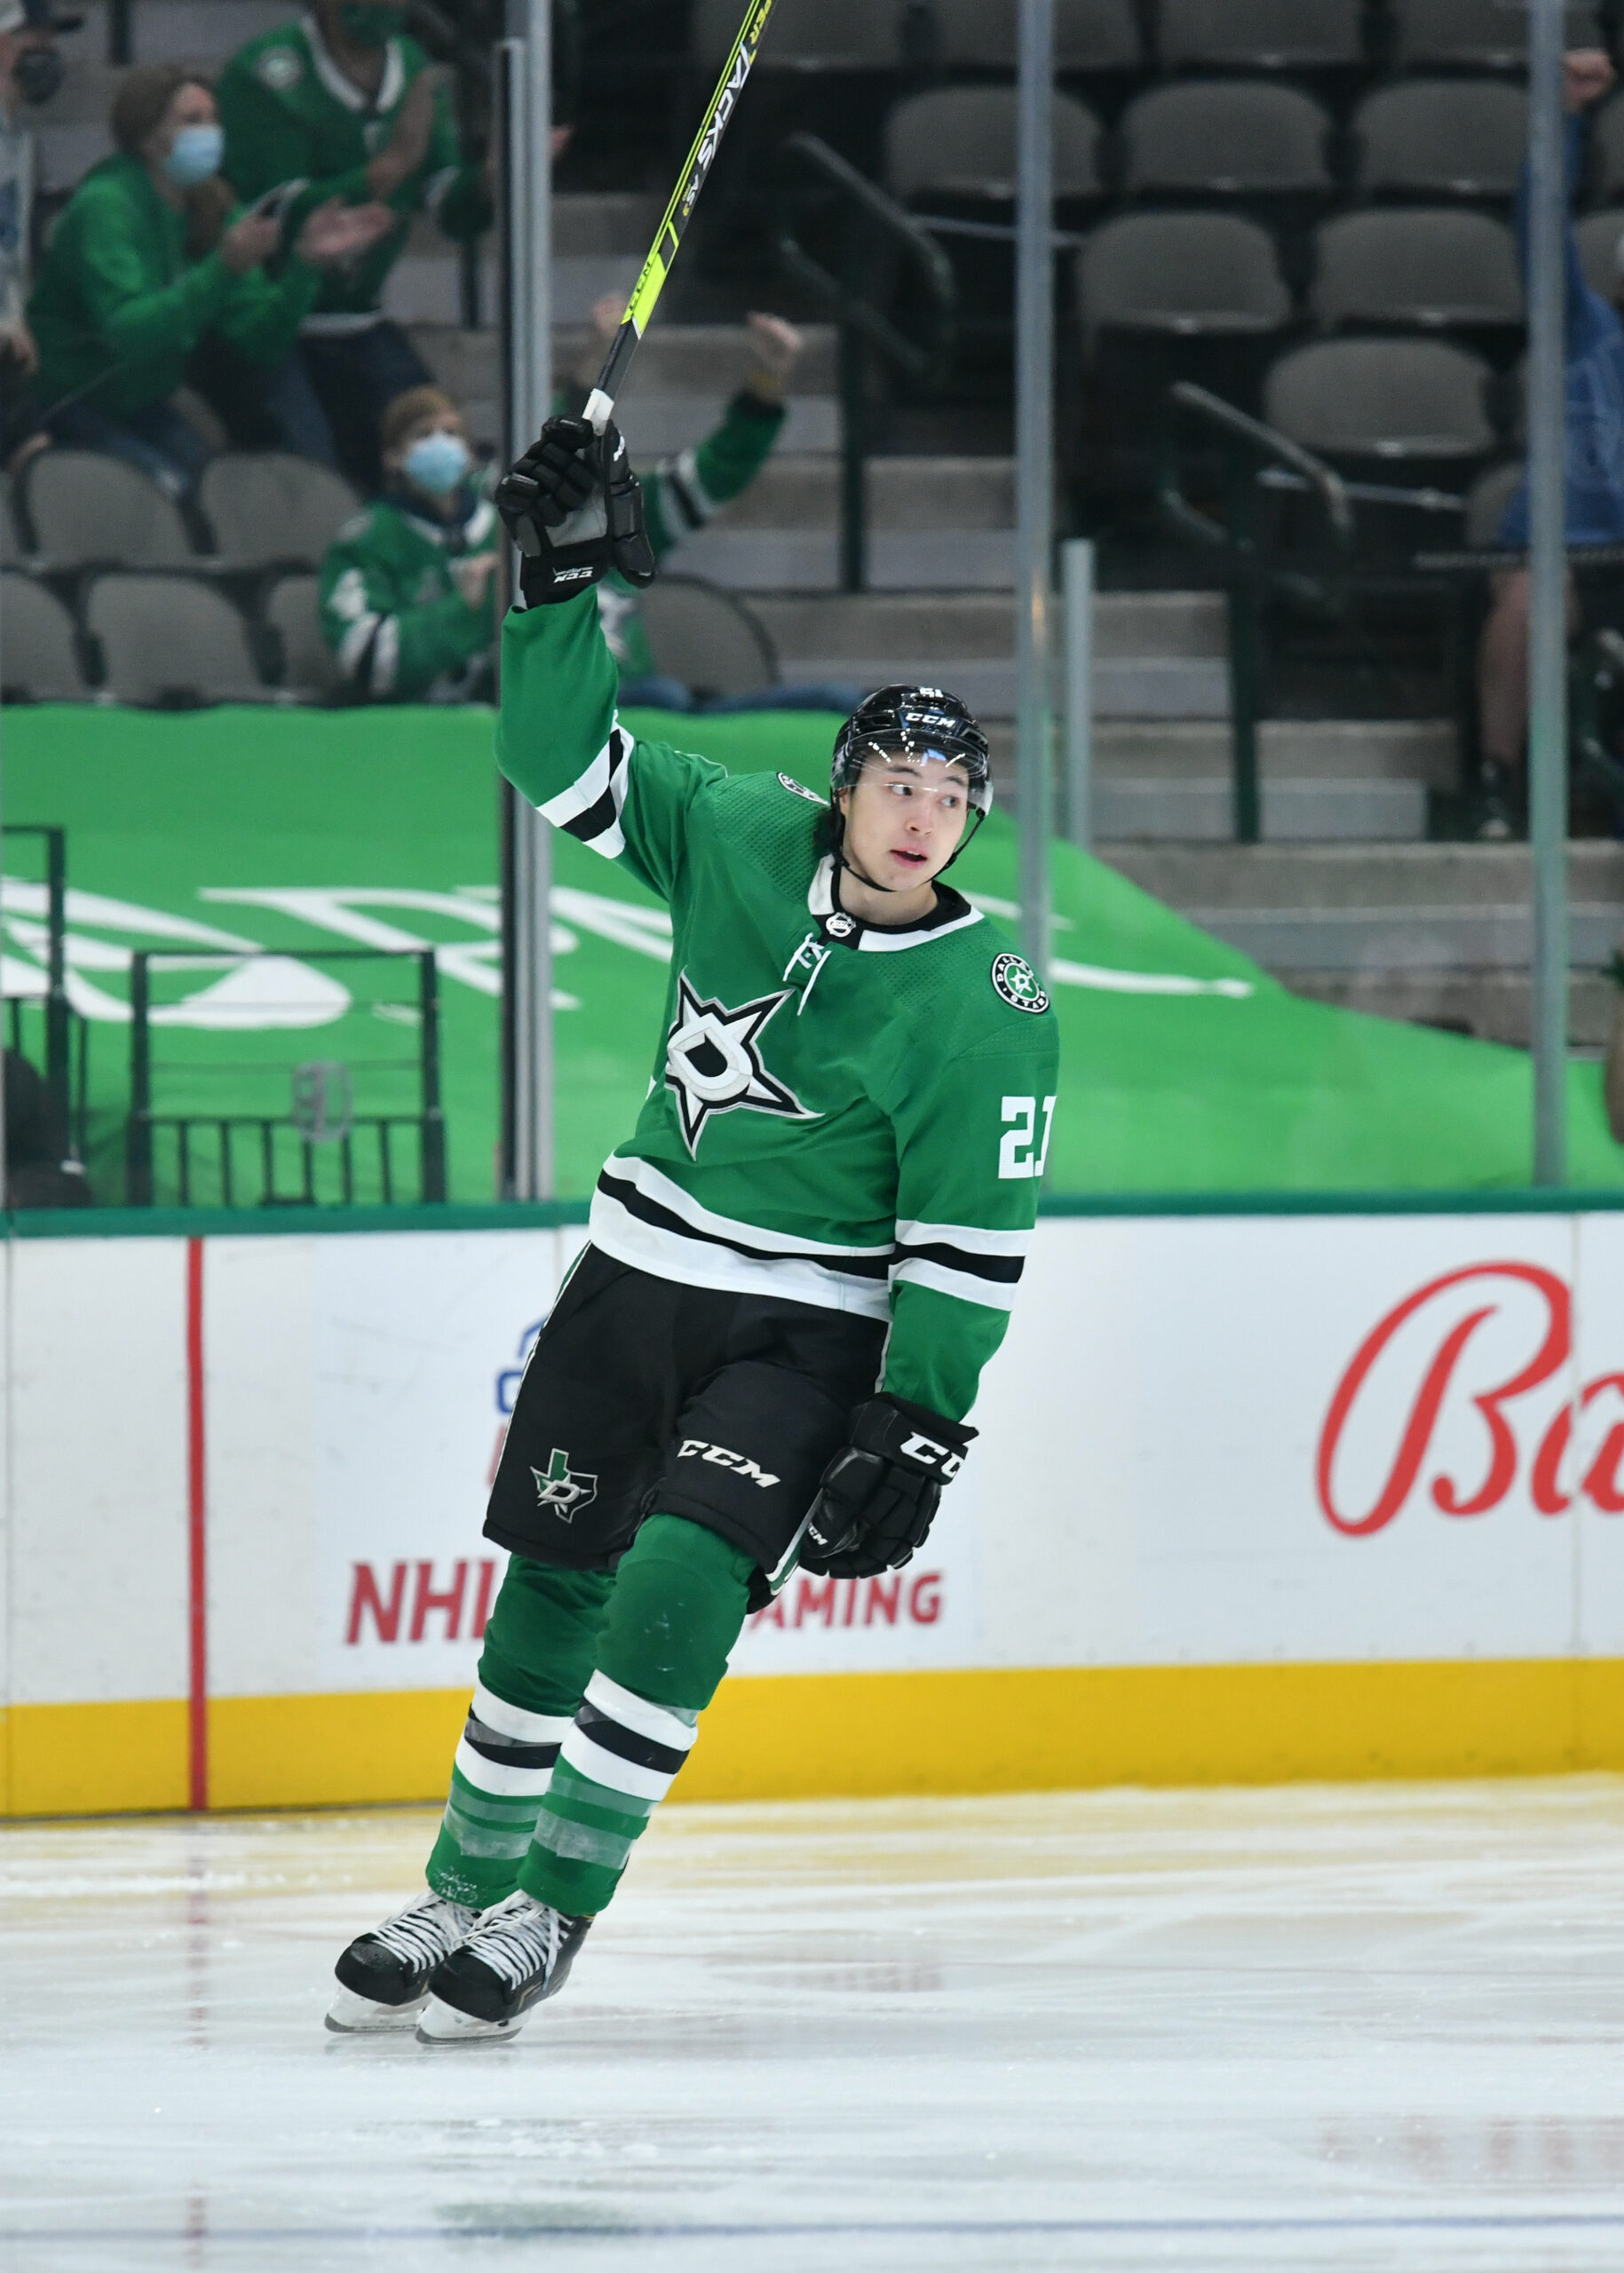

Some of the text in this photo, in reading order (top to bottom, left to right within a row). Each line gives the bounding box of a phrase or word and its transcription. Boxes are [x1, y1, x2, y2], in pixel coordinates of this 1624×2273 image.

[697, 41, 757, 170] TACKS
[906, 713, 955, 727] CCM
[998, 1096, 1058, 1179] 21
[677, 1439, 780, 1488] CCM
[809, 1523, 828, 1545] CM
[749, 1570, 944, 1629] AMING
